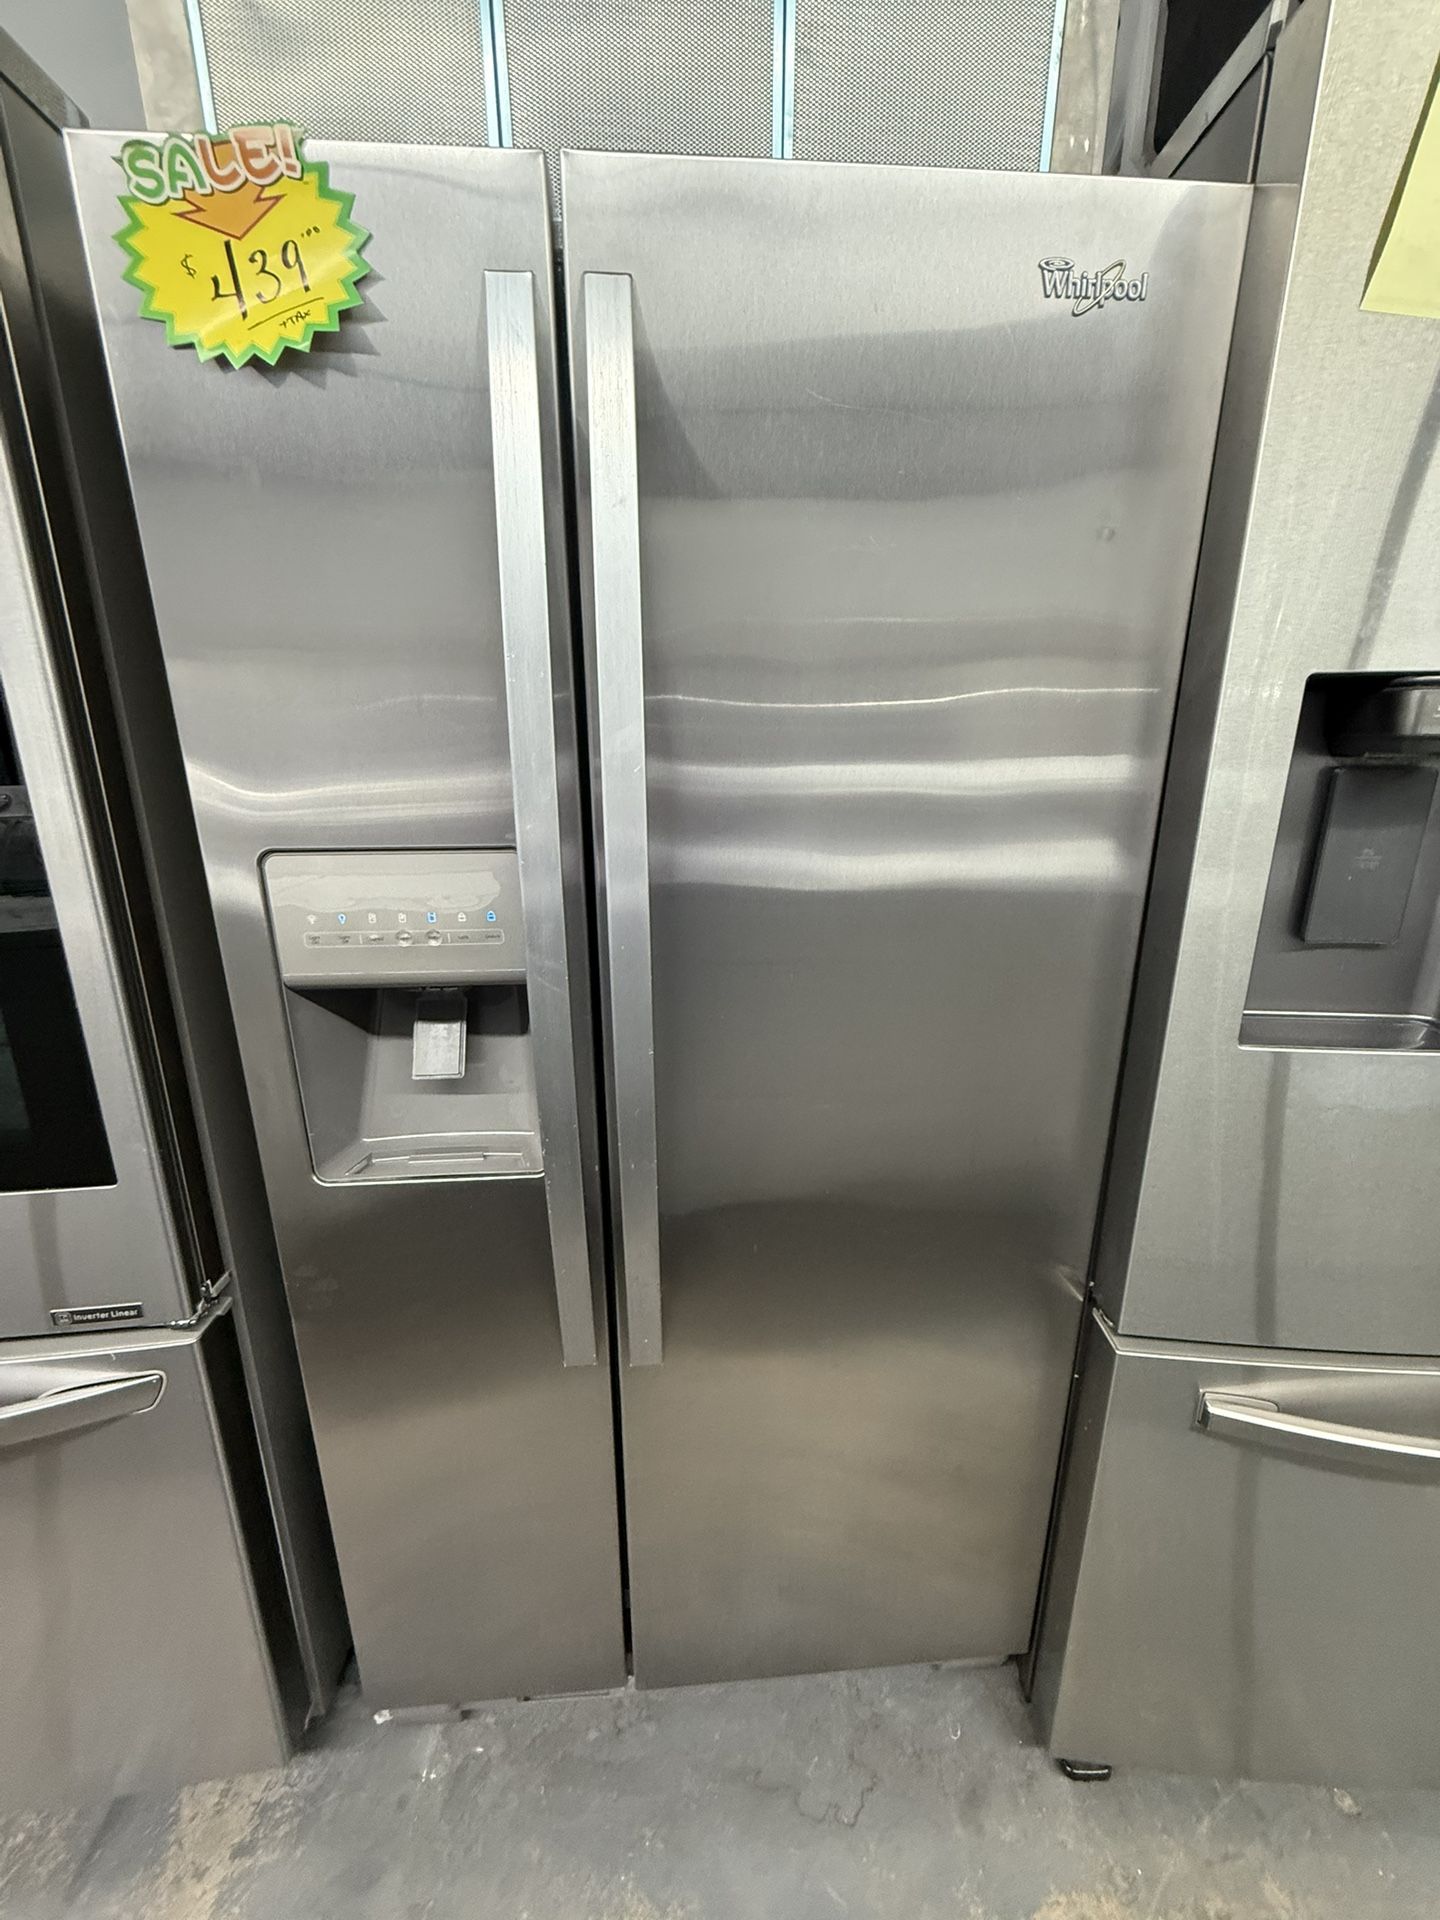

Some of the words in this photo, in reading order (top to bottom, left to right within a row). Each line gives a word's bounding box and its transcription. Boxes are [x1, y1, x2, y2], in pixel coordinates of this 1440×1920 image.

[124, 125, 302, 204] SALE!
[1040, 267, 1149, 311] Whirlpool
[73, 1312, 109, 1321] Inverter
[110, 1309, 138, 1317] Linear
